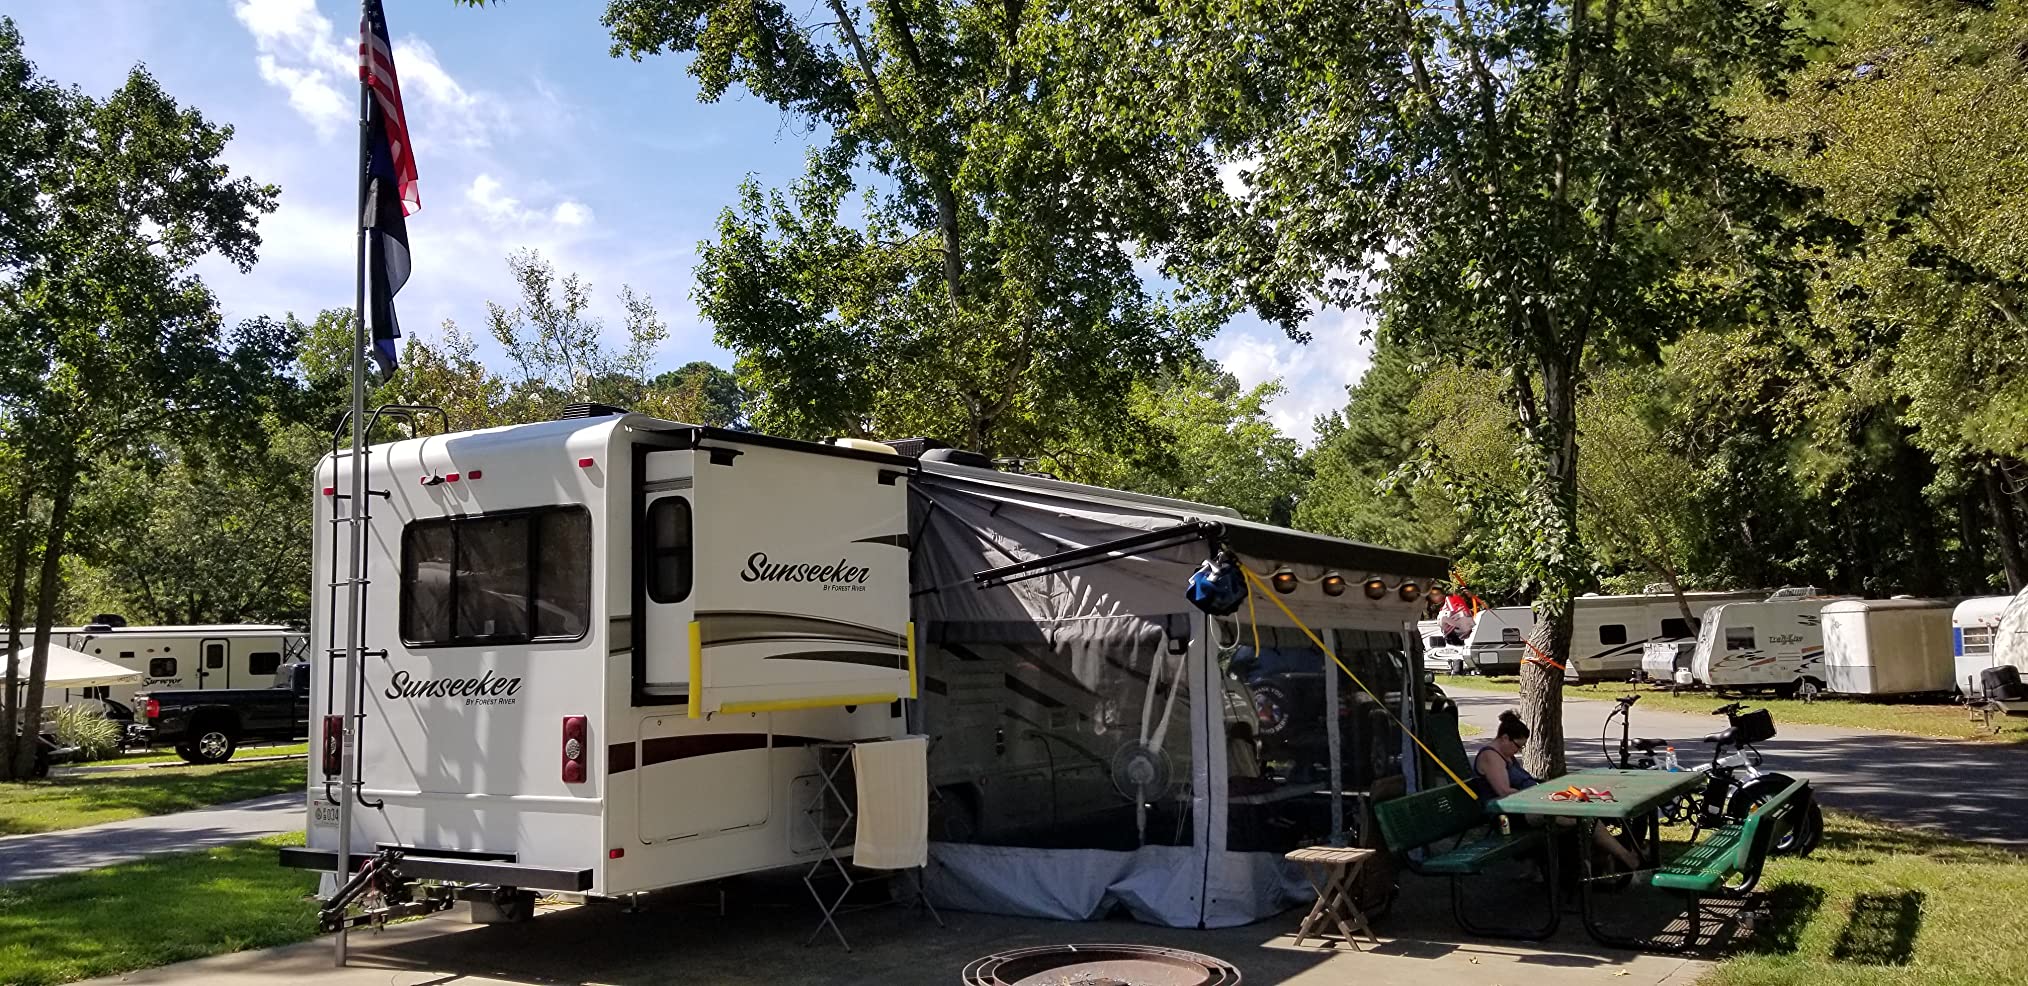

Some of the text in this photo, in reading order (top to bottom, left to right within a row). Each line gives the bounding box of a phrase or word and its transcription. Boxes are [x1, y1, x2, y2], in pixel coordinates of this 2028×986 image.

[740, 552, 870, 584] Sunseeker
[143, 677, 183, 687] Surveyor
[385, 670, 522, 700] Sunseeker
